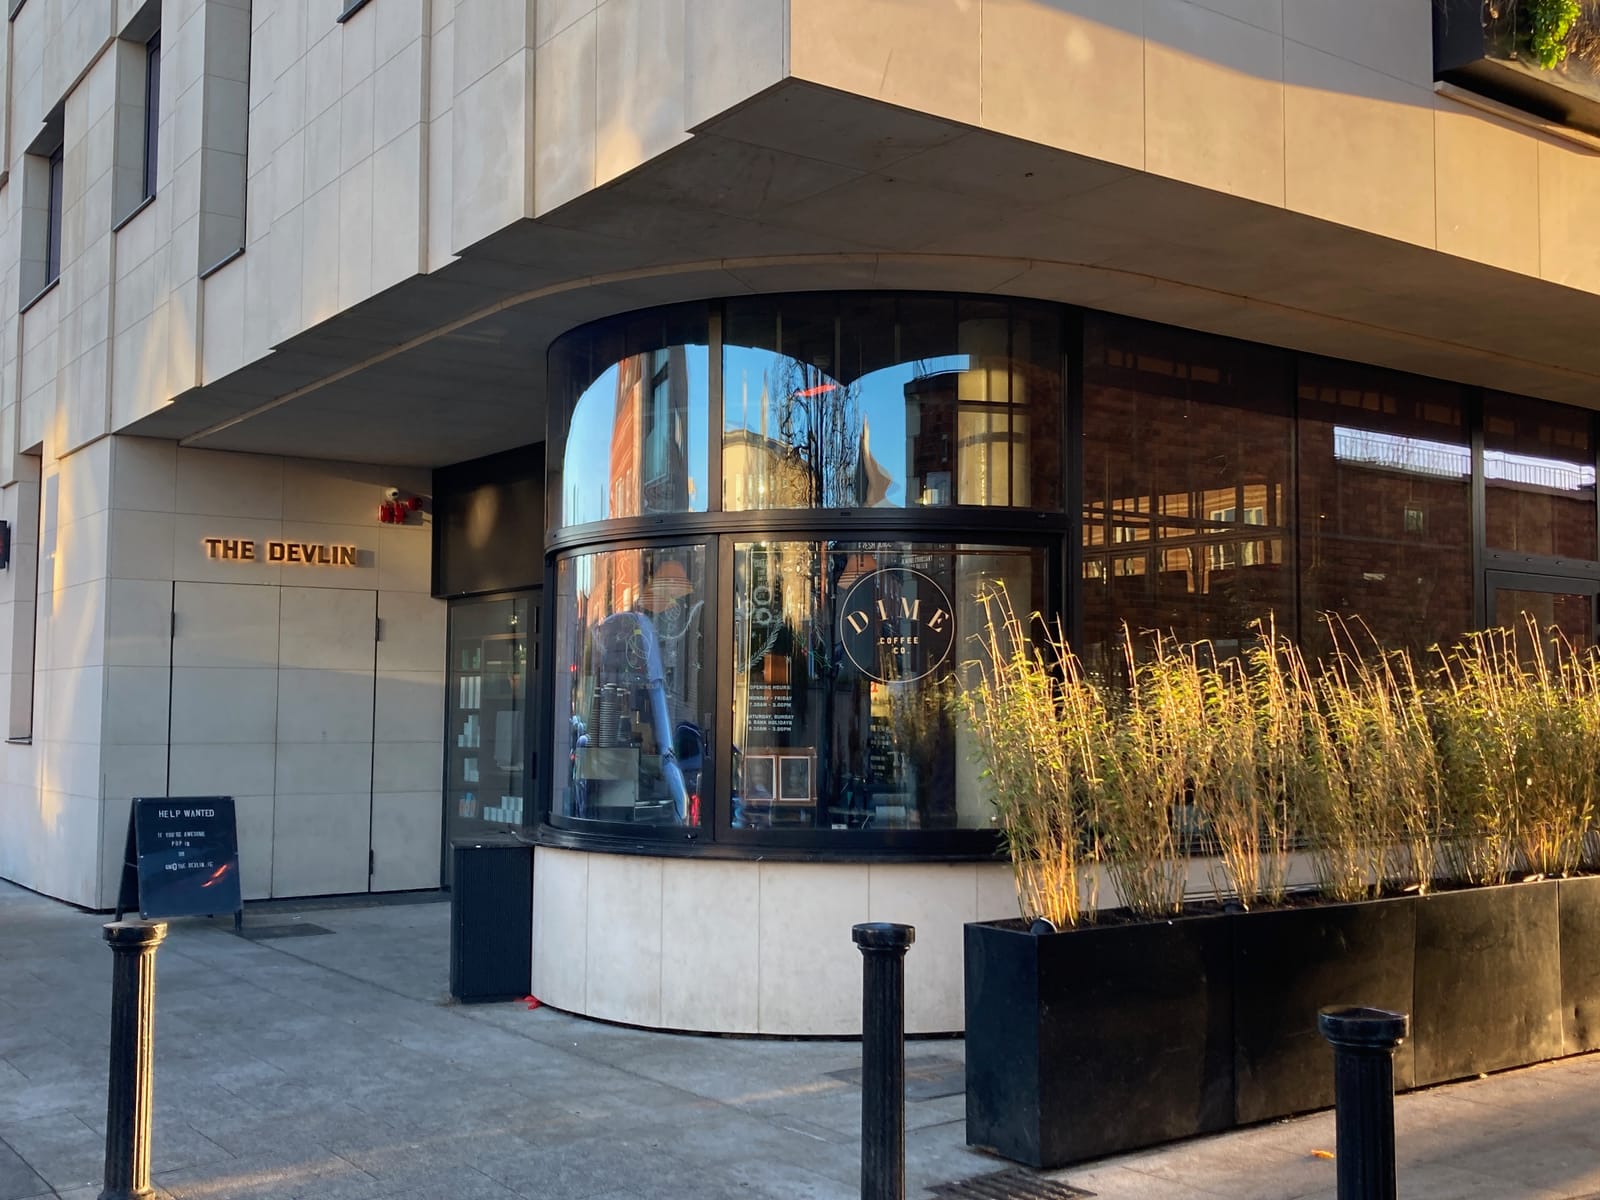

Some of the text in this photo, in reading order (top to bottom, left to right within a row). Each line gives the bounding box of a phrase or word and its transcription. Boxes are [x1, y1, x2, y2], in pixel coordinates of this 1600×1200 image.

[205, 538, 356, 566] THE DEVLIN
[845, 597, 949, 635] DIME
[879, 636, 919, 645] COFFEE
[158, 809, 215, 818] HELP WANTED
